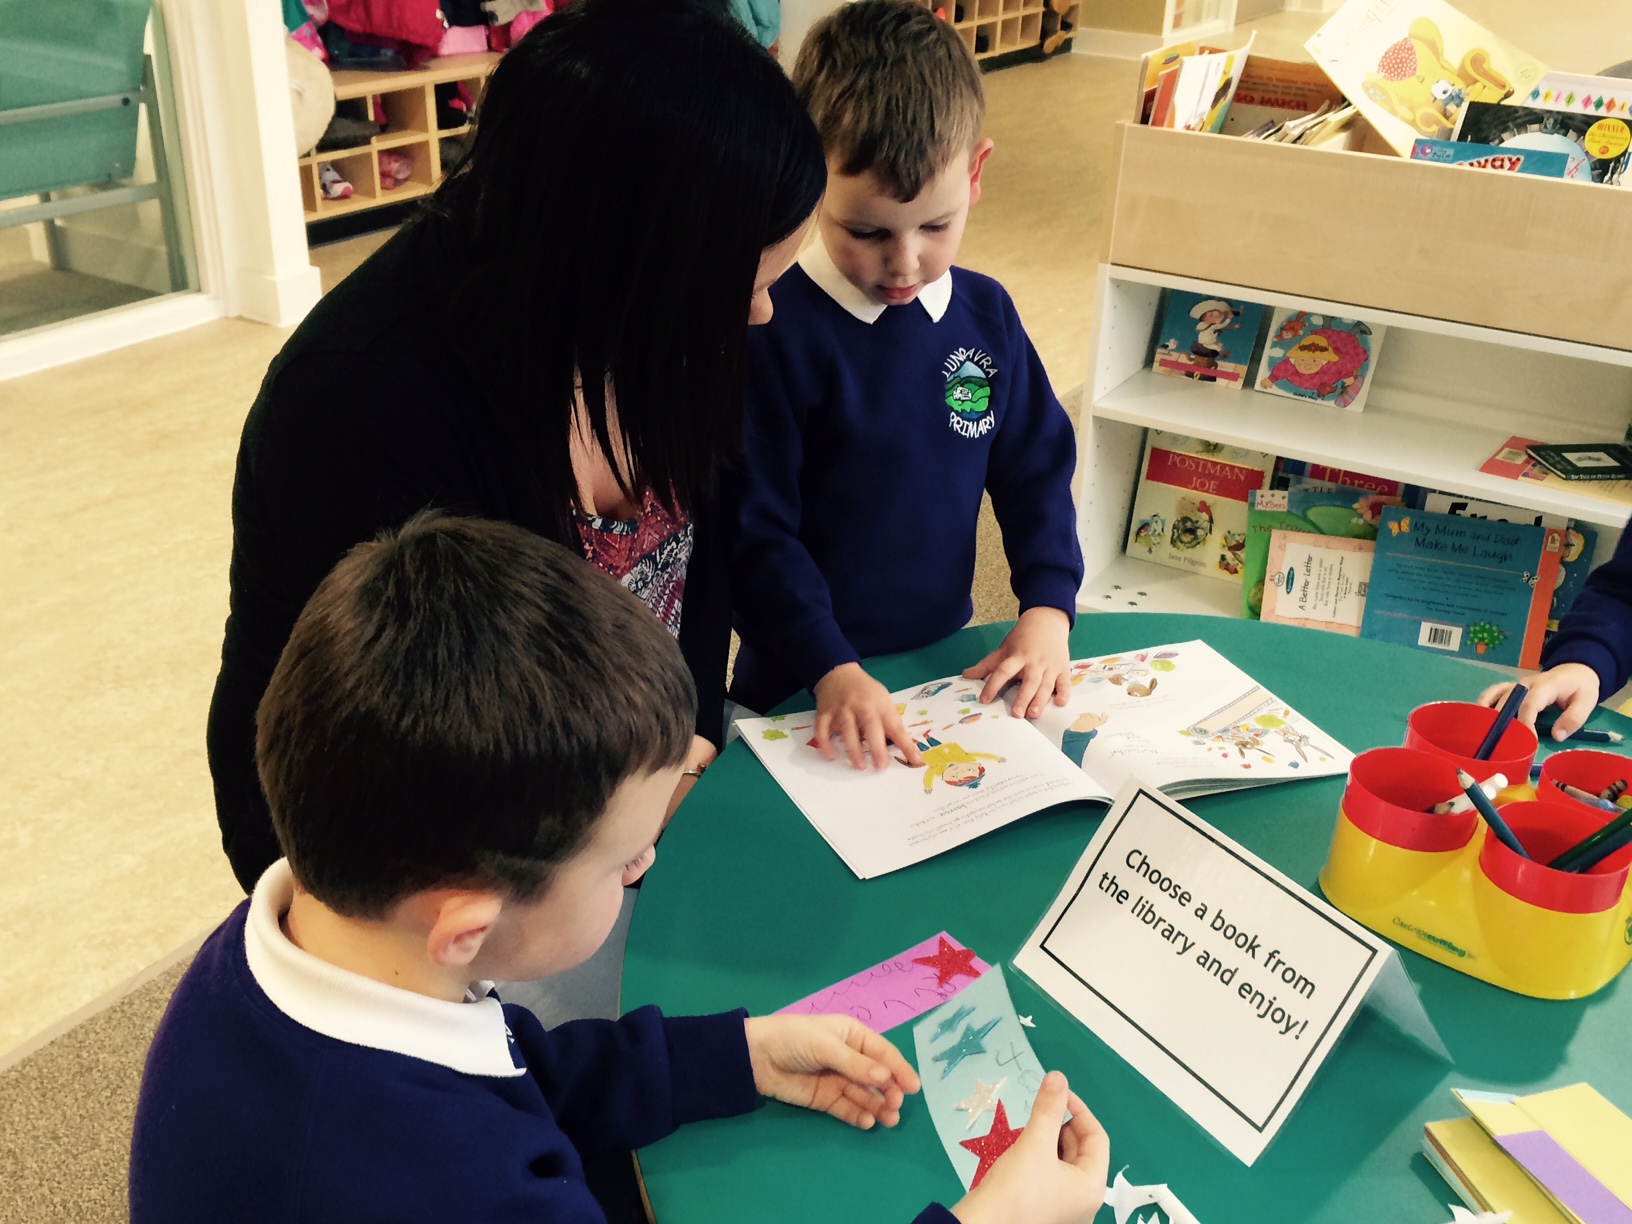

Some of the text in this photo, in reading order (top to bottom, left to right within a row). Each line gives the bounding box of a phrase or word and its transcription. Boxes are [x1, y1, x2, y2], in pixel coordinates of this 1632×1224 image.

[1260, 95, 1308, 111] MUCH
[941, 347, 999, 378] LUNDAVRA
[948, 410, 995, 439] PRIMARY
[1167, 453, 1247, 482] POSTMAN
[1320, 464, 1389, 496] Three
[1187, 476, 1219, 494] JOE
[1413, 521, 1520, 546] My Mum and Dad
[1414, 537, 1513, 564] Make Me Laugh
[1303, 553, 1313, 577] Letter
[1299, 578, 1310, 603] Better
[1125, 848, 1317, 1000] Choose a book from
[1098, 871, 1309, 1041] the library and enjoy!
